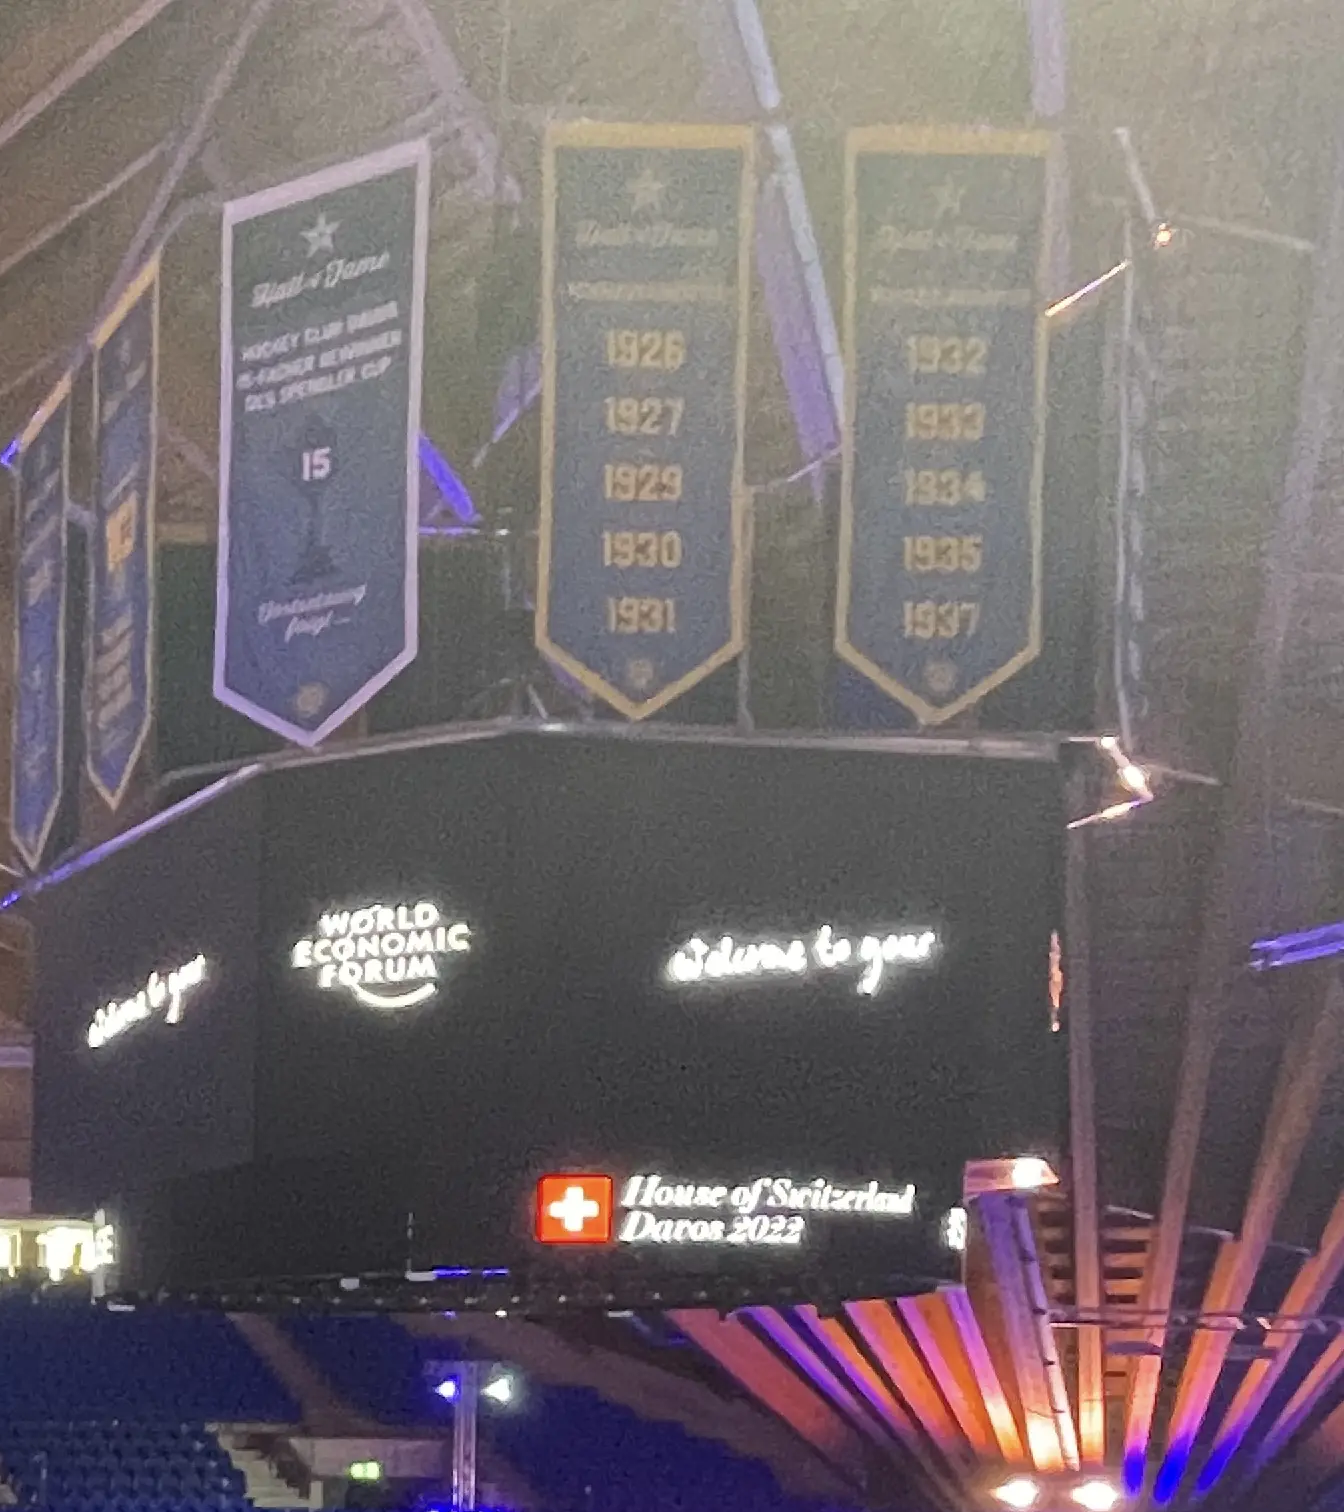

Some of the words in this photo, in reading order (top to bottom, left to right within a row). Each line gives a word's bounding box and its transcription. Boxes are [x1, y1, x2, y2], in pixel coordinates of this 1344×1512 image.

[906, 335, 988, 377] 1932
[603, 397, 685, 438] 1927
[302, 446, 331, 481] 15
[604, 463, 683, 502] 1929
[905, 468, 987, 506] 1934
[603, 530, 682, 568] 1930
[903, 535, 983, 572] 1935
[606, 597, 677, 634] 1931
[904, 602, 981, 639] 1937
[318, 902, 440, 937] WORLD
[291, 923, 472, 968] ECONOMIC
[814, 924, 852, 967] to
[857, 930, 936, 995] your
[318, 955, 438, 988] FORUM
[621, 1174, 728, 1209] House
[729, 1178, 772, 1213] of
[772, 1177, 916, 1214] Switzerland
[618, 1210, 725, 1243] Davos
[726, 1214, 805, 1243] 2022
